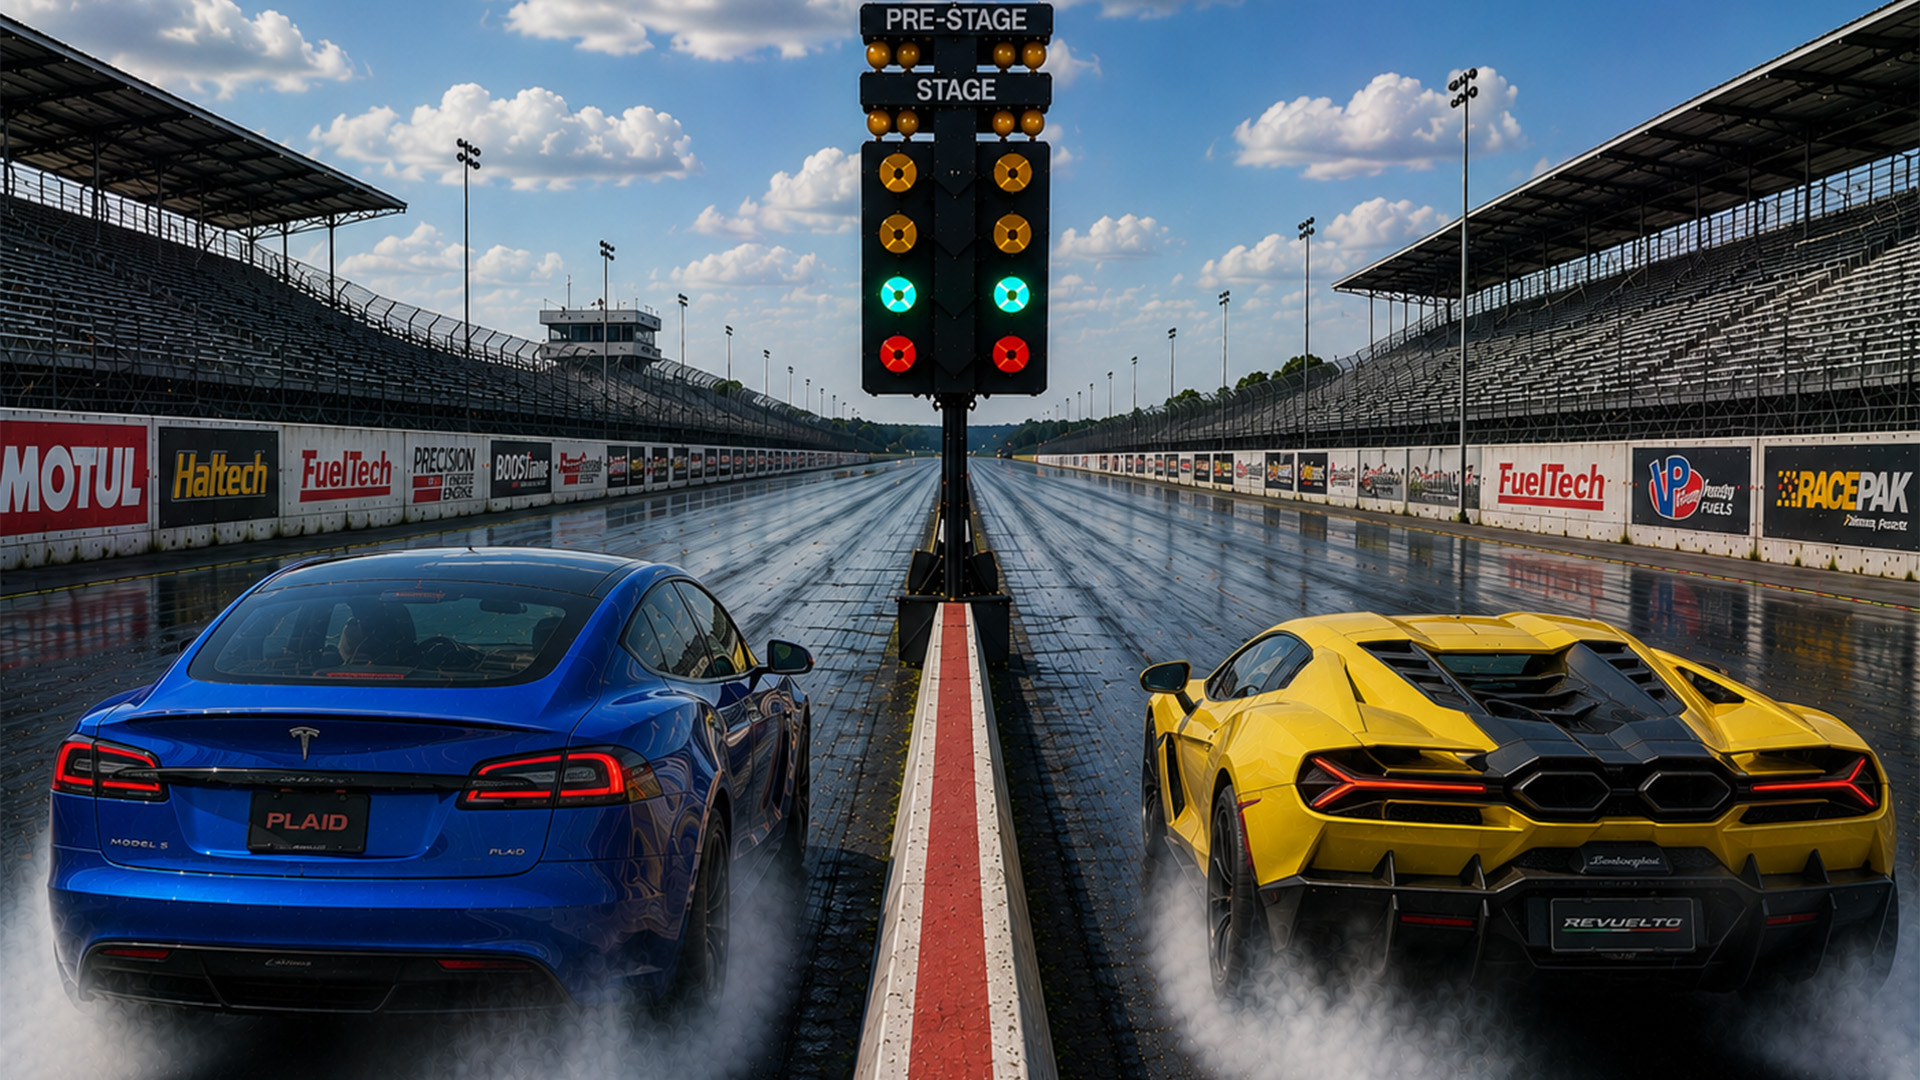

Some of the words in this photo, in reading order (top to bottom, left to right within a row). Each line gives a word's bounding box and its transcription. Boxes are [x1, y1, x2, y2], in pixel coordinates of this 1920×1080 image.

[886, 8, 1028, 31] PRE-STAGE
[916, 78, 997, 101] STAGE
[172, 451, 268, 499] Haltech
[301, 449, 392, 488] FuelTech
[413, 446, 476, 474] PRECISION
[0, 445, 141, 513] MOTUL
[1499, 462, 1605, 500] FuelTech
[1649, 455, 1691, 519] VP
[1796, 470, 1913, 514] RACEPAK
[1701, 501, 1733, 516] FUELS
[266, 812, 348, 831] PLAID
[1563, 918, 1683, 928] REVUELTO
